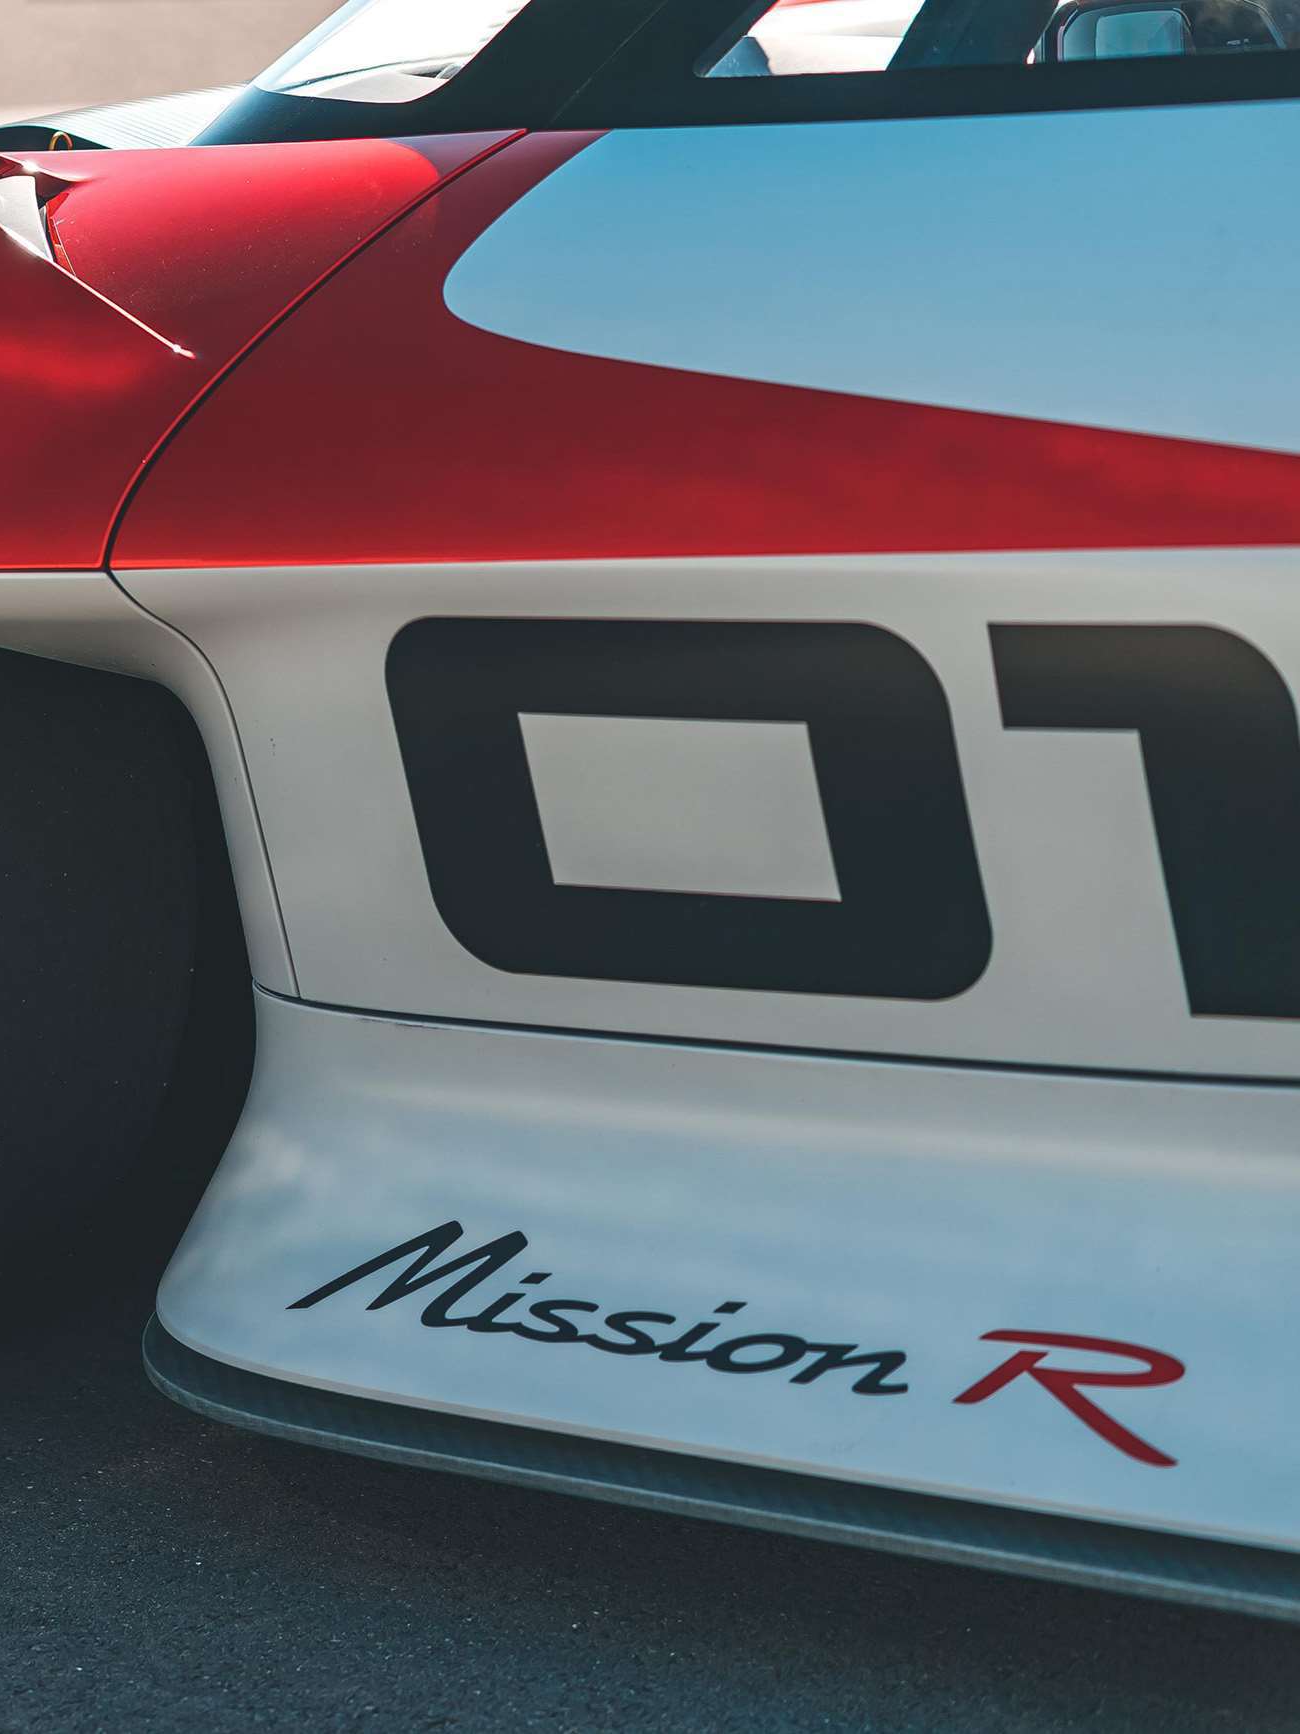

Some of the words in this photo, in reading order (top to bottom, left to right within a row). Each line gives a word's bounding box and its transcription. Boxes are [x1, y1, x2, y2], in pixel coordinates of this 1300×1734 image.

[384, 615, 1300, 1021] 01
[285, 1220, 909, 1396] Mission
[954, 1330, 1186, 1468] R
